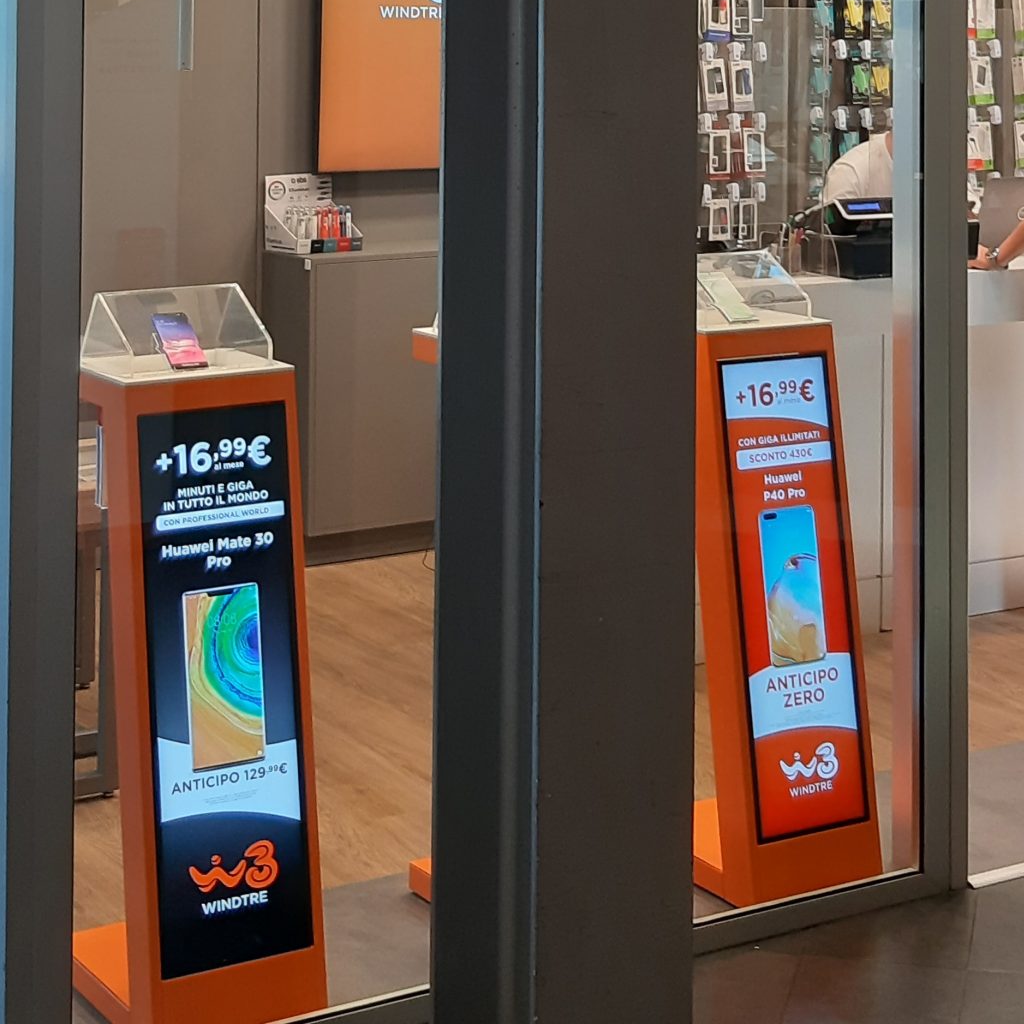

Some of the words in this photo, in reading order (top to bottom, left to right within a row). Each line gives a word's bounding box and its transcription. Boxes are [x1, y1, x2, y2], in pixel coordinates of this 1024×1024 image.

[738, 438, 756, 447] CON
[758, 435, 779, 445] GIGA
[780, 431, 820, 442] ILLIMITATI
[749, 450, 787, 463] SCONTO
[764, 471, 802, 485] Huawei
[177, 484, 215, 498] MINUTI
[217, 483, 225, 494] E
[227, 480, 254, 491] GIGA
[763, 490, 785, 501] P40
[788, 487, 806, 499] Pro
[163, 500, 175, 511] IN
[178, 496, 213, 510] TUTTO
[215, 494, 225, 505] IL
[228, 490, 269, 503] MONDO
[163, 517, 181, 526] CON
[182, 511, 240, 524] PROFESSIONAL
[242, 507, 270, 517] WORLD
[162, 542, 214, 558] Huawei
[217, 536, 252, 551] Mate
[255, 531, 274, 546] 30
[207, 556, 232, 569] Pro
[766, 667, 839, 693] ANTICIPO
[783, 688, 825, 708] ZERO
[171, 772, 240, 795] ANTICIPO
[789, 780, 833, 798] WINDTRE
[201, 890, 269, 915] WINDTRE
